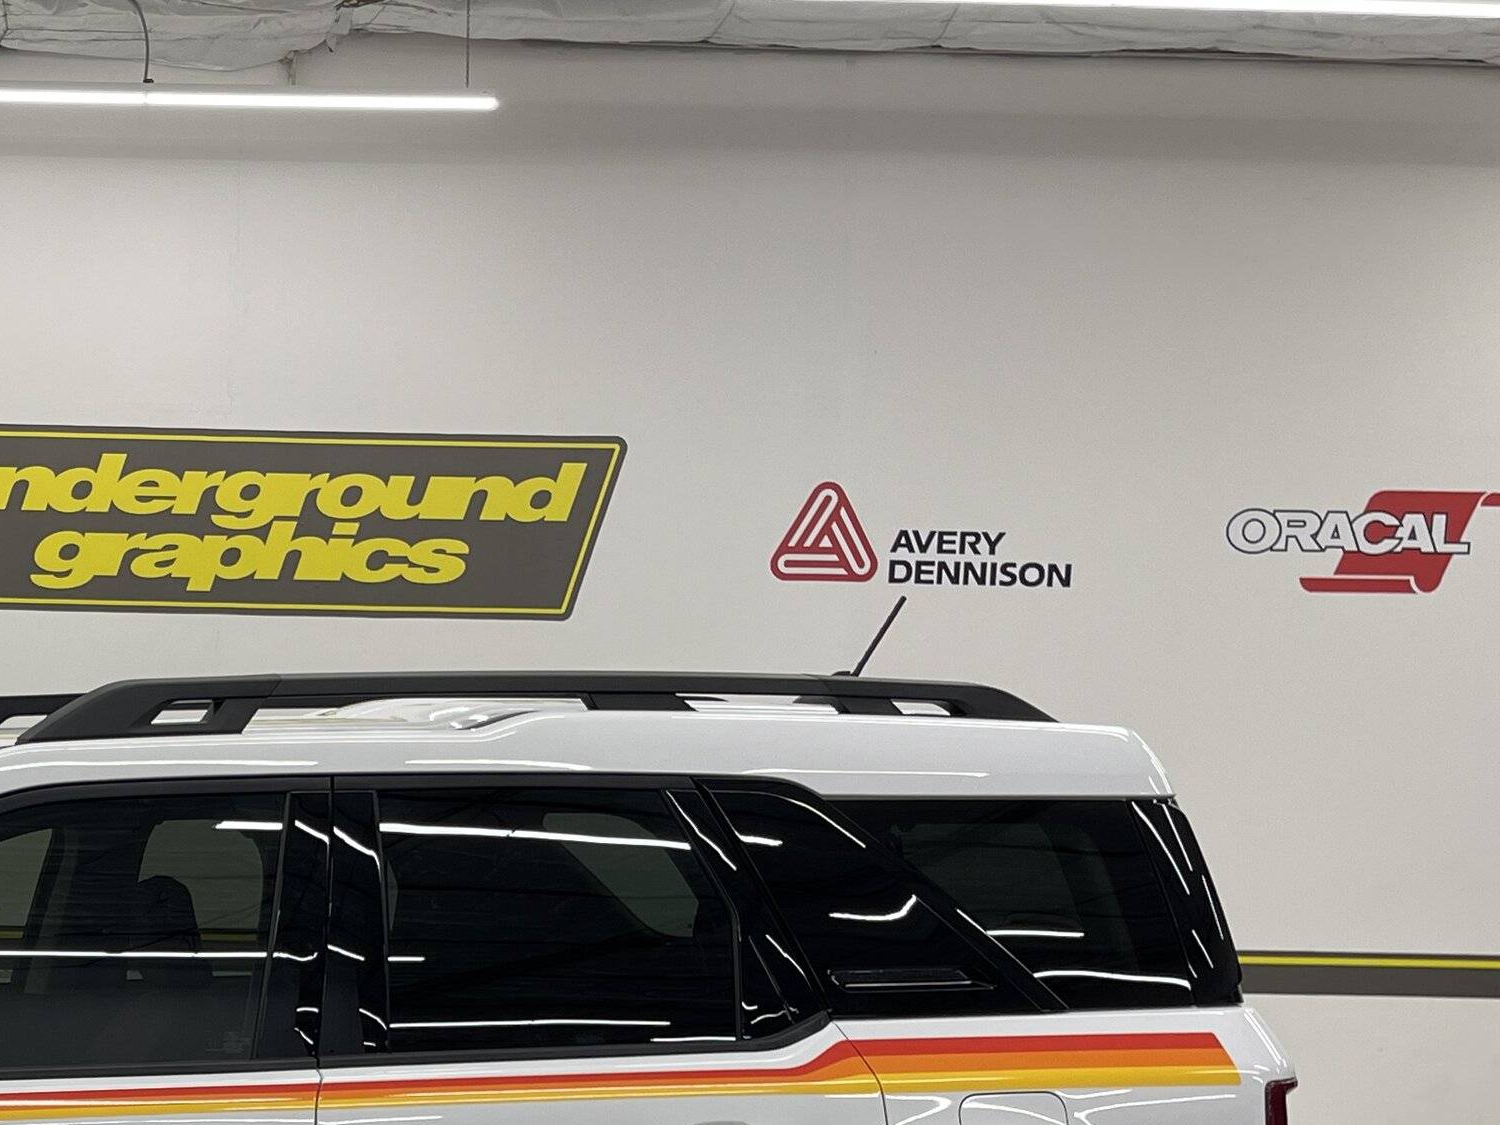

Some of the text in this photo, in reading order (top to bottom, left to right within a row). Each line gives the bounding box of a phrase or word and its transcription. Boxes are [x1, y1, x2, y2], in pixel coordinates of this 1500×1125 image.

[890, 529, 1006, 555] AVERY
[1226, 508, 1471, 555] ORACAL
[30, 521, 470, 592] graphics
[888, 560, 1072, 588] DENNISON
